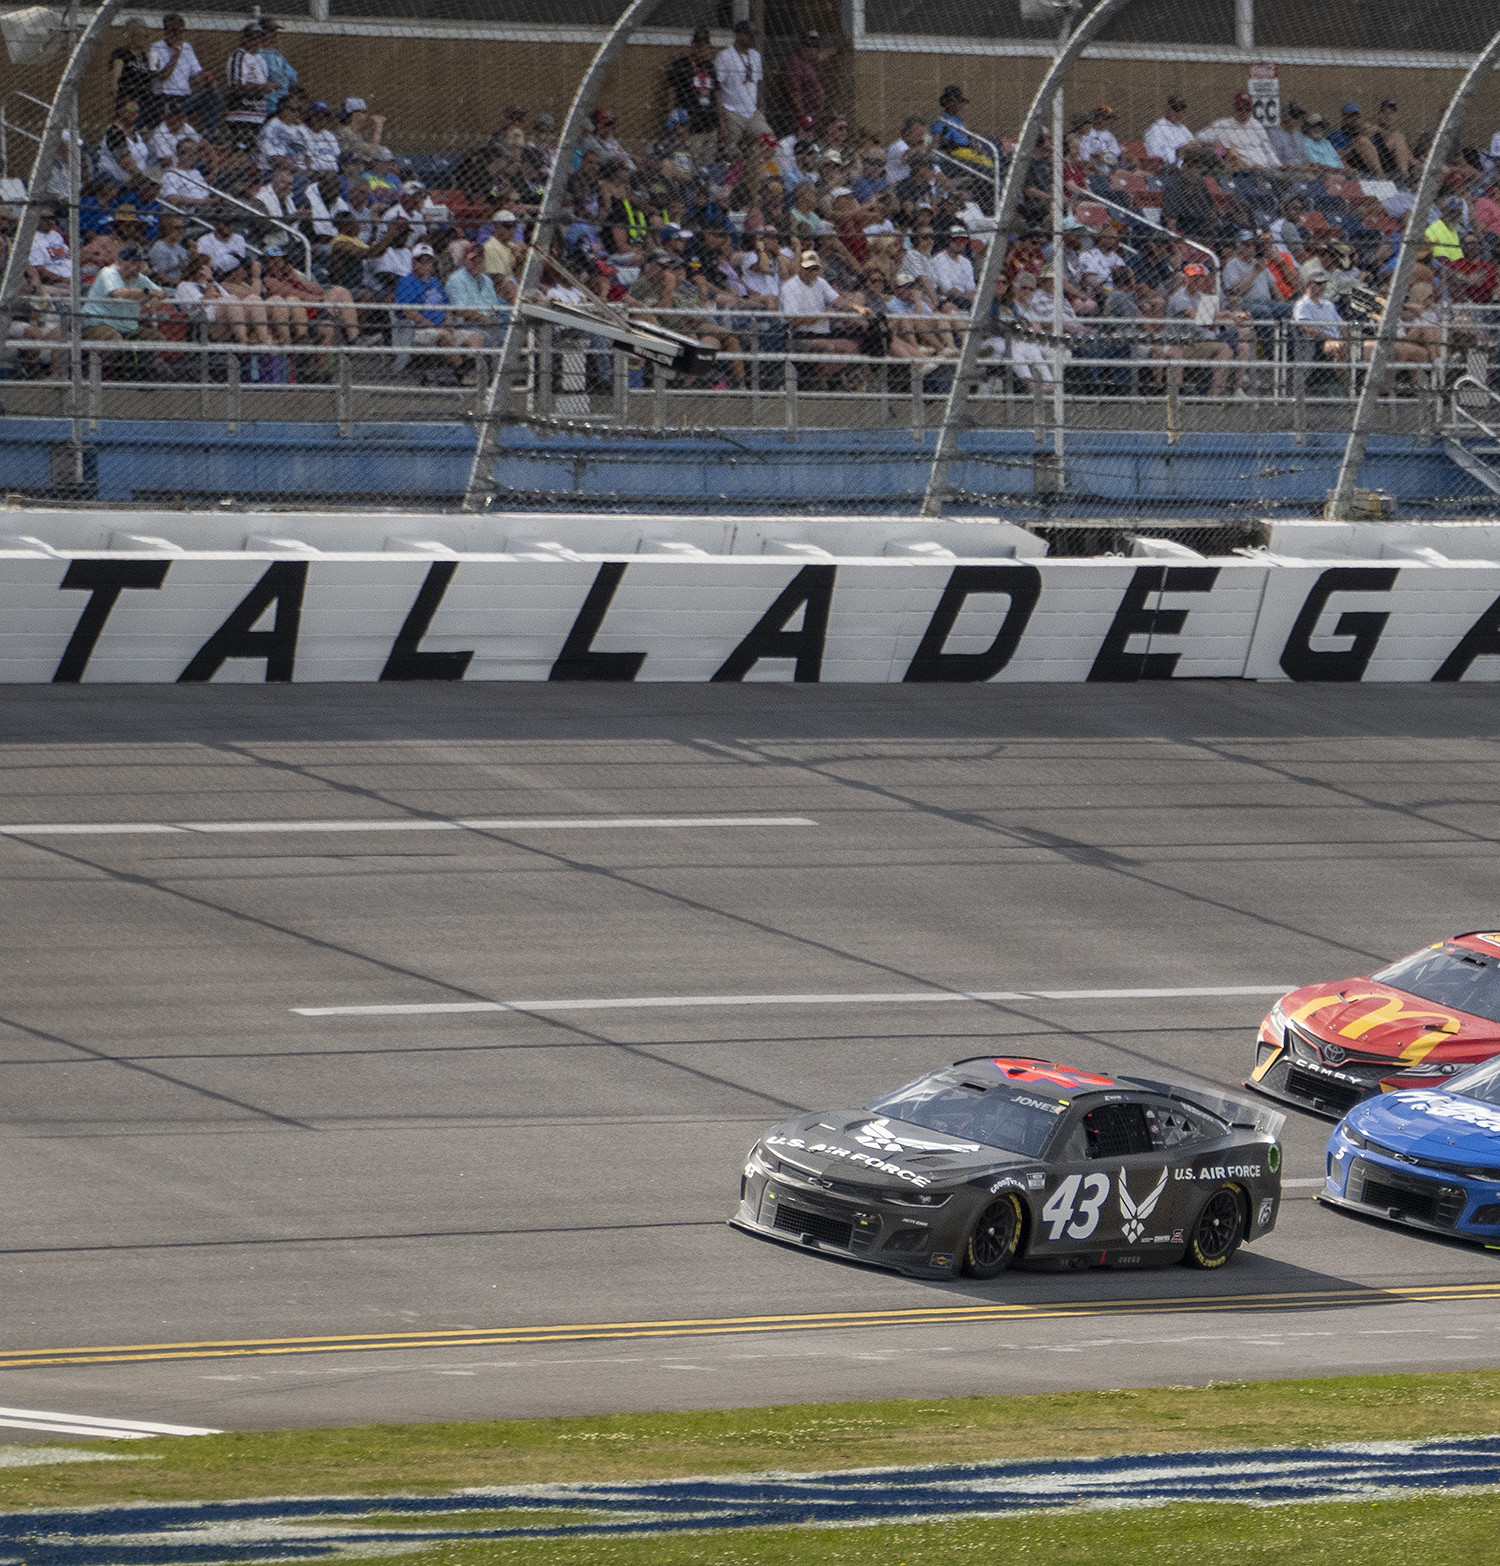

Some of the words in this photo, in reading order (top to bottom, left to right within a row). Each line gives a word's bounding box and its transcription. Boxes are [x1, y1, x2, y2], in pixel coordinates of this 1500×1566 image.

[1296, 1059, 1362, 1084] CAMRY
[1011, 1096, 1060, 1114] JONES
[765, 1136, 805, 1149] U.S.
[808, 1143, 852, 1158] AIR
[850, 1153, 932, 1189] FORCE
[1174, 1168, 1196, 1181] U.S.
[1200, 1166, 1227, 1180] AIR
[1228, 1165, 1261, 1178] FORCE
[1042, 1173, 1111, 1241] 43
